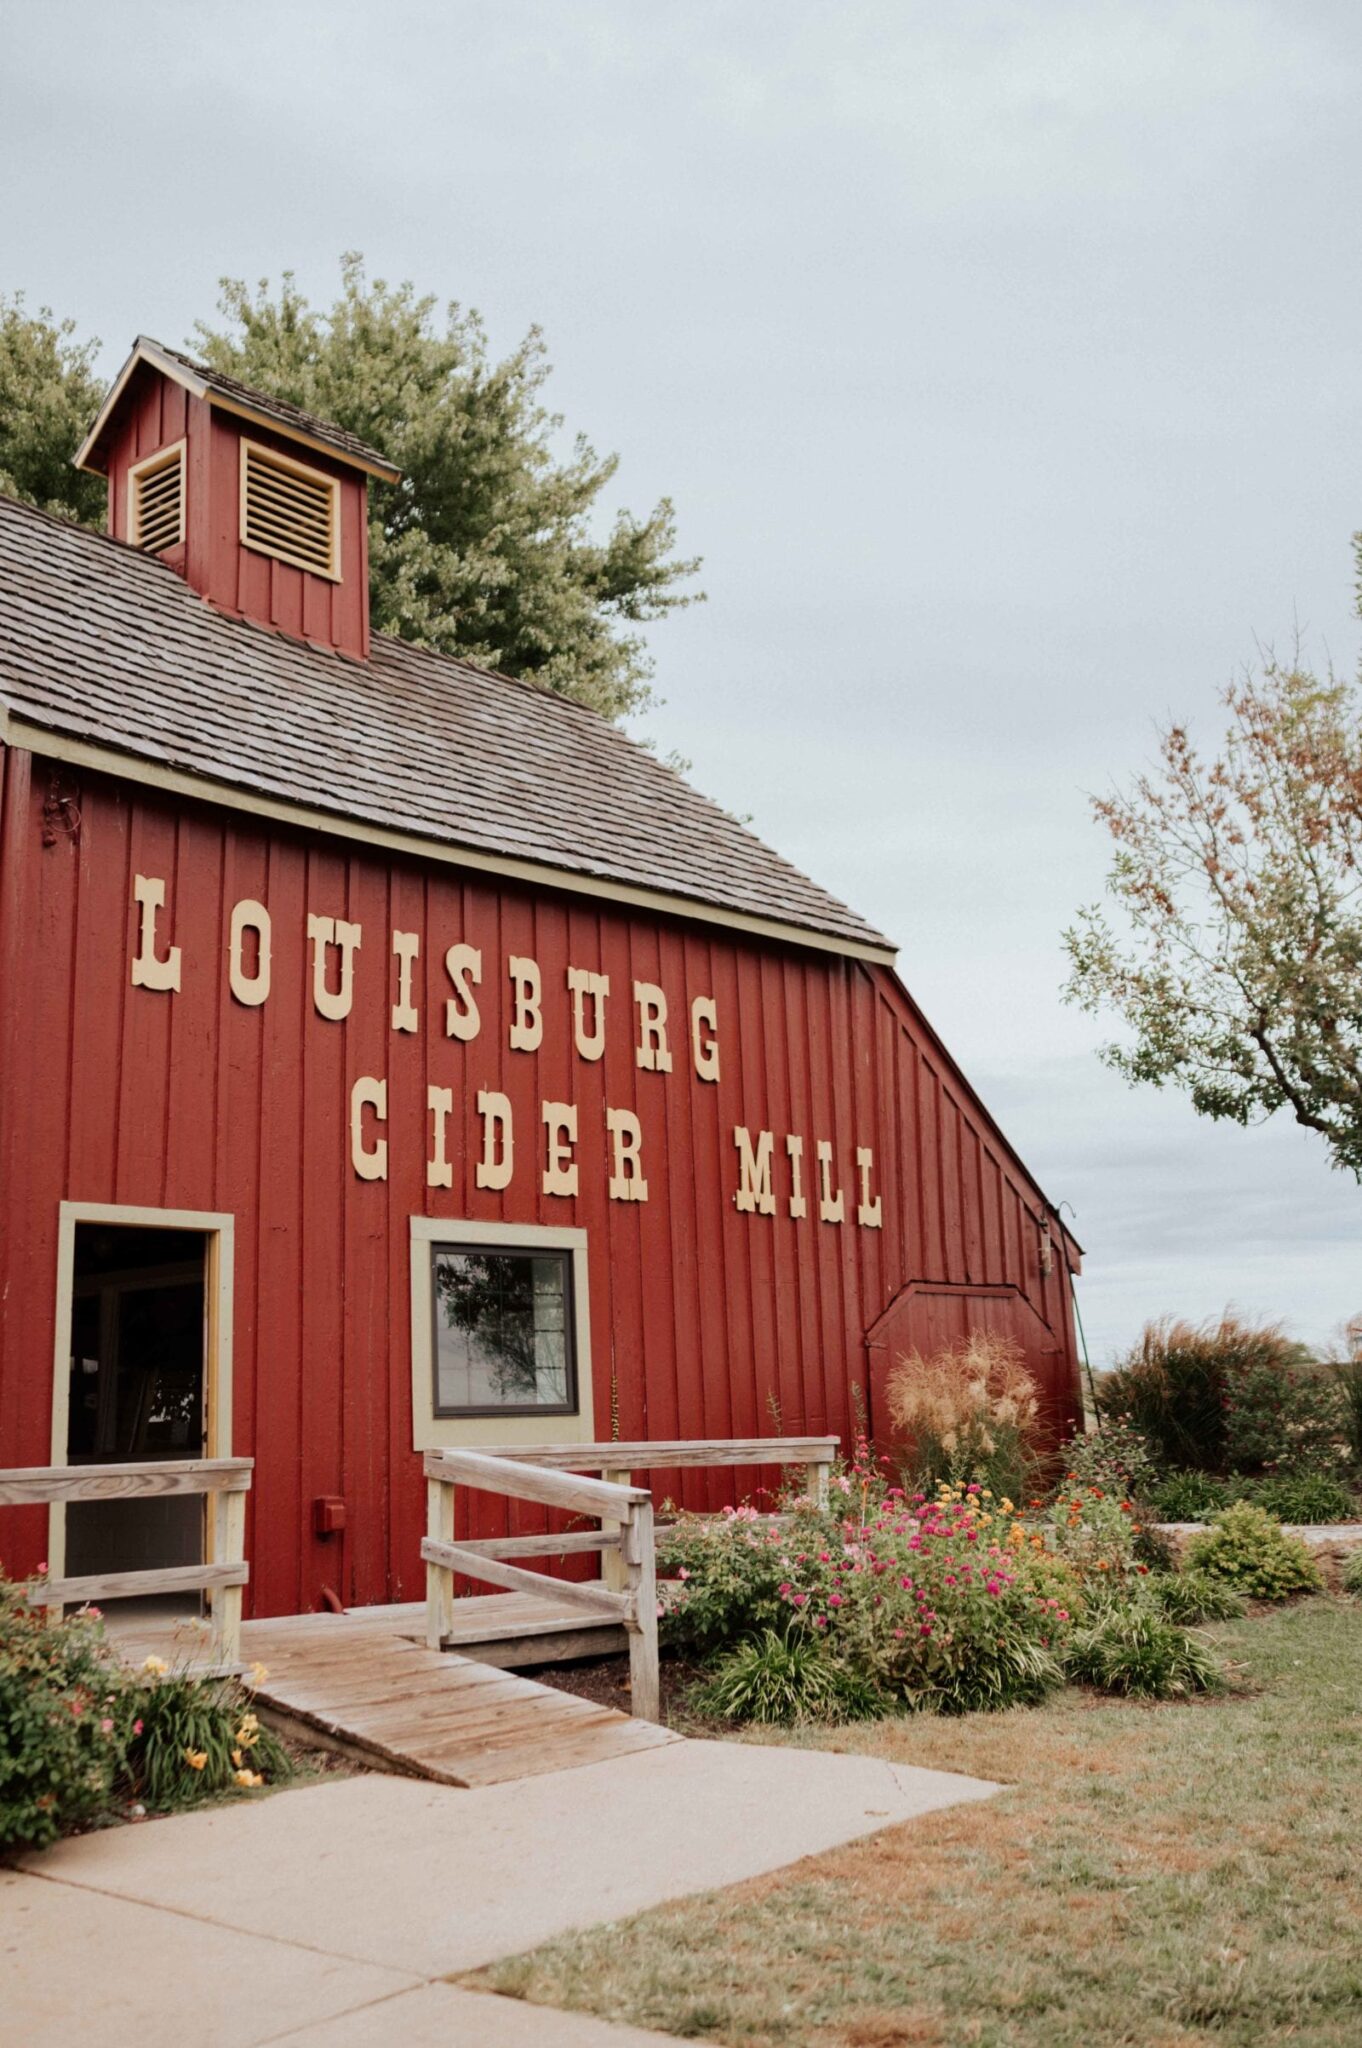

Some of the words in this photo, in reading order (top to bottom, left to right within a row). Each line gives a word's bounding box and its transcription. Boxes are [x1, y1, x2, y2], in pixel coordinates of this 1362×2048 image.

[131, 874, 721, 1083] LOUISBURG
[350, 1076, 649, 1202] CIDER
[734, 1126, 883, 1228] MILL
